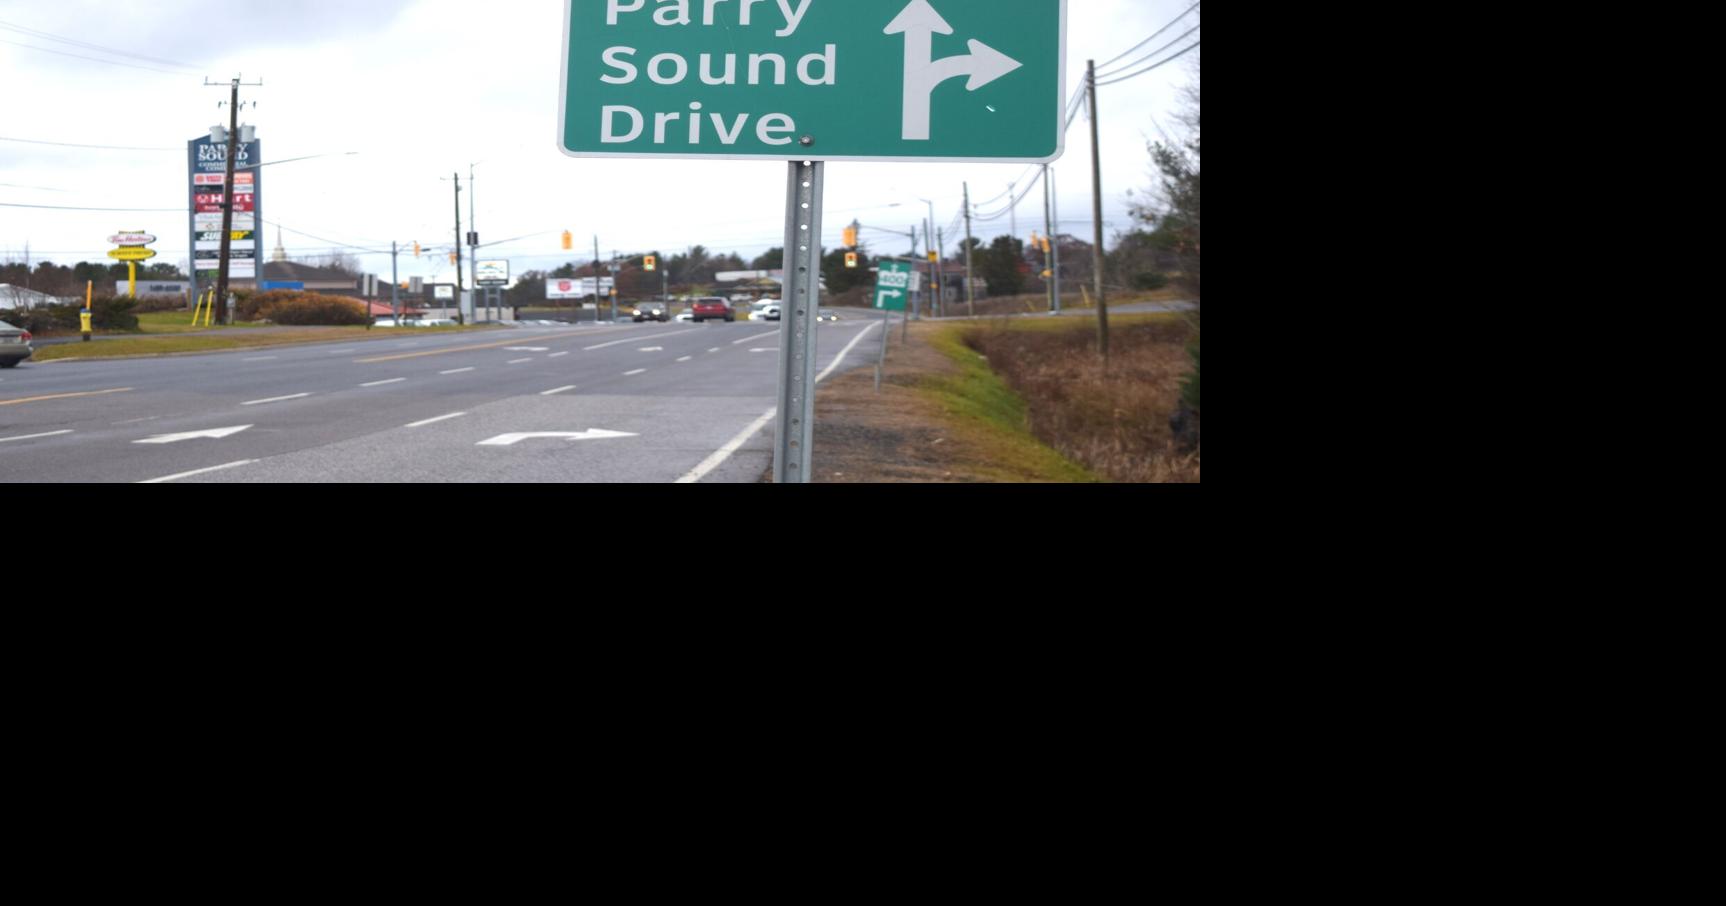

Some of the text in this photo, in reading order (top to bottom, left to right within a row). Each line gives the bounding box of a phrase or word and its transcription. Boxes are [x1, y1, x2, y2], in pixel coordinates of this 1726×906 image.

[606, 0, 811, 36] Parry
[599, 43, 836, 85] Sound
[600, 101, 796, 145] Drive
[199, 144, 248, 153] PARY
[198, 151, 249, 161] SOUD
[211, 194, 251, 203] Hrt
[200, 231, 249, 241] SUAY
[881, 275, 904, 285] 400
